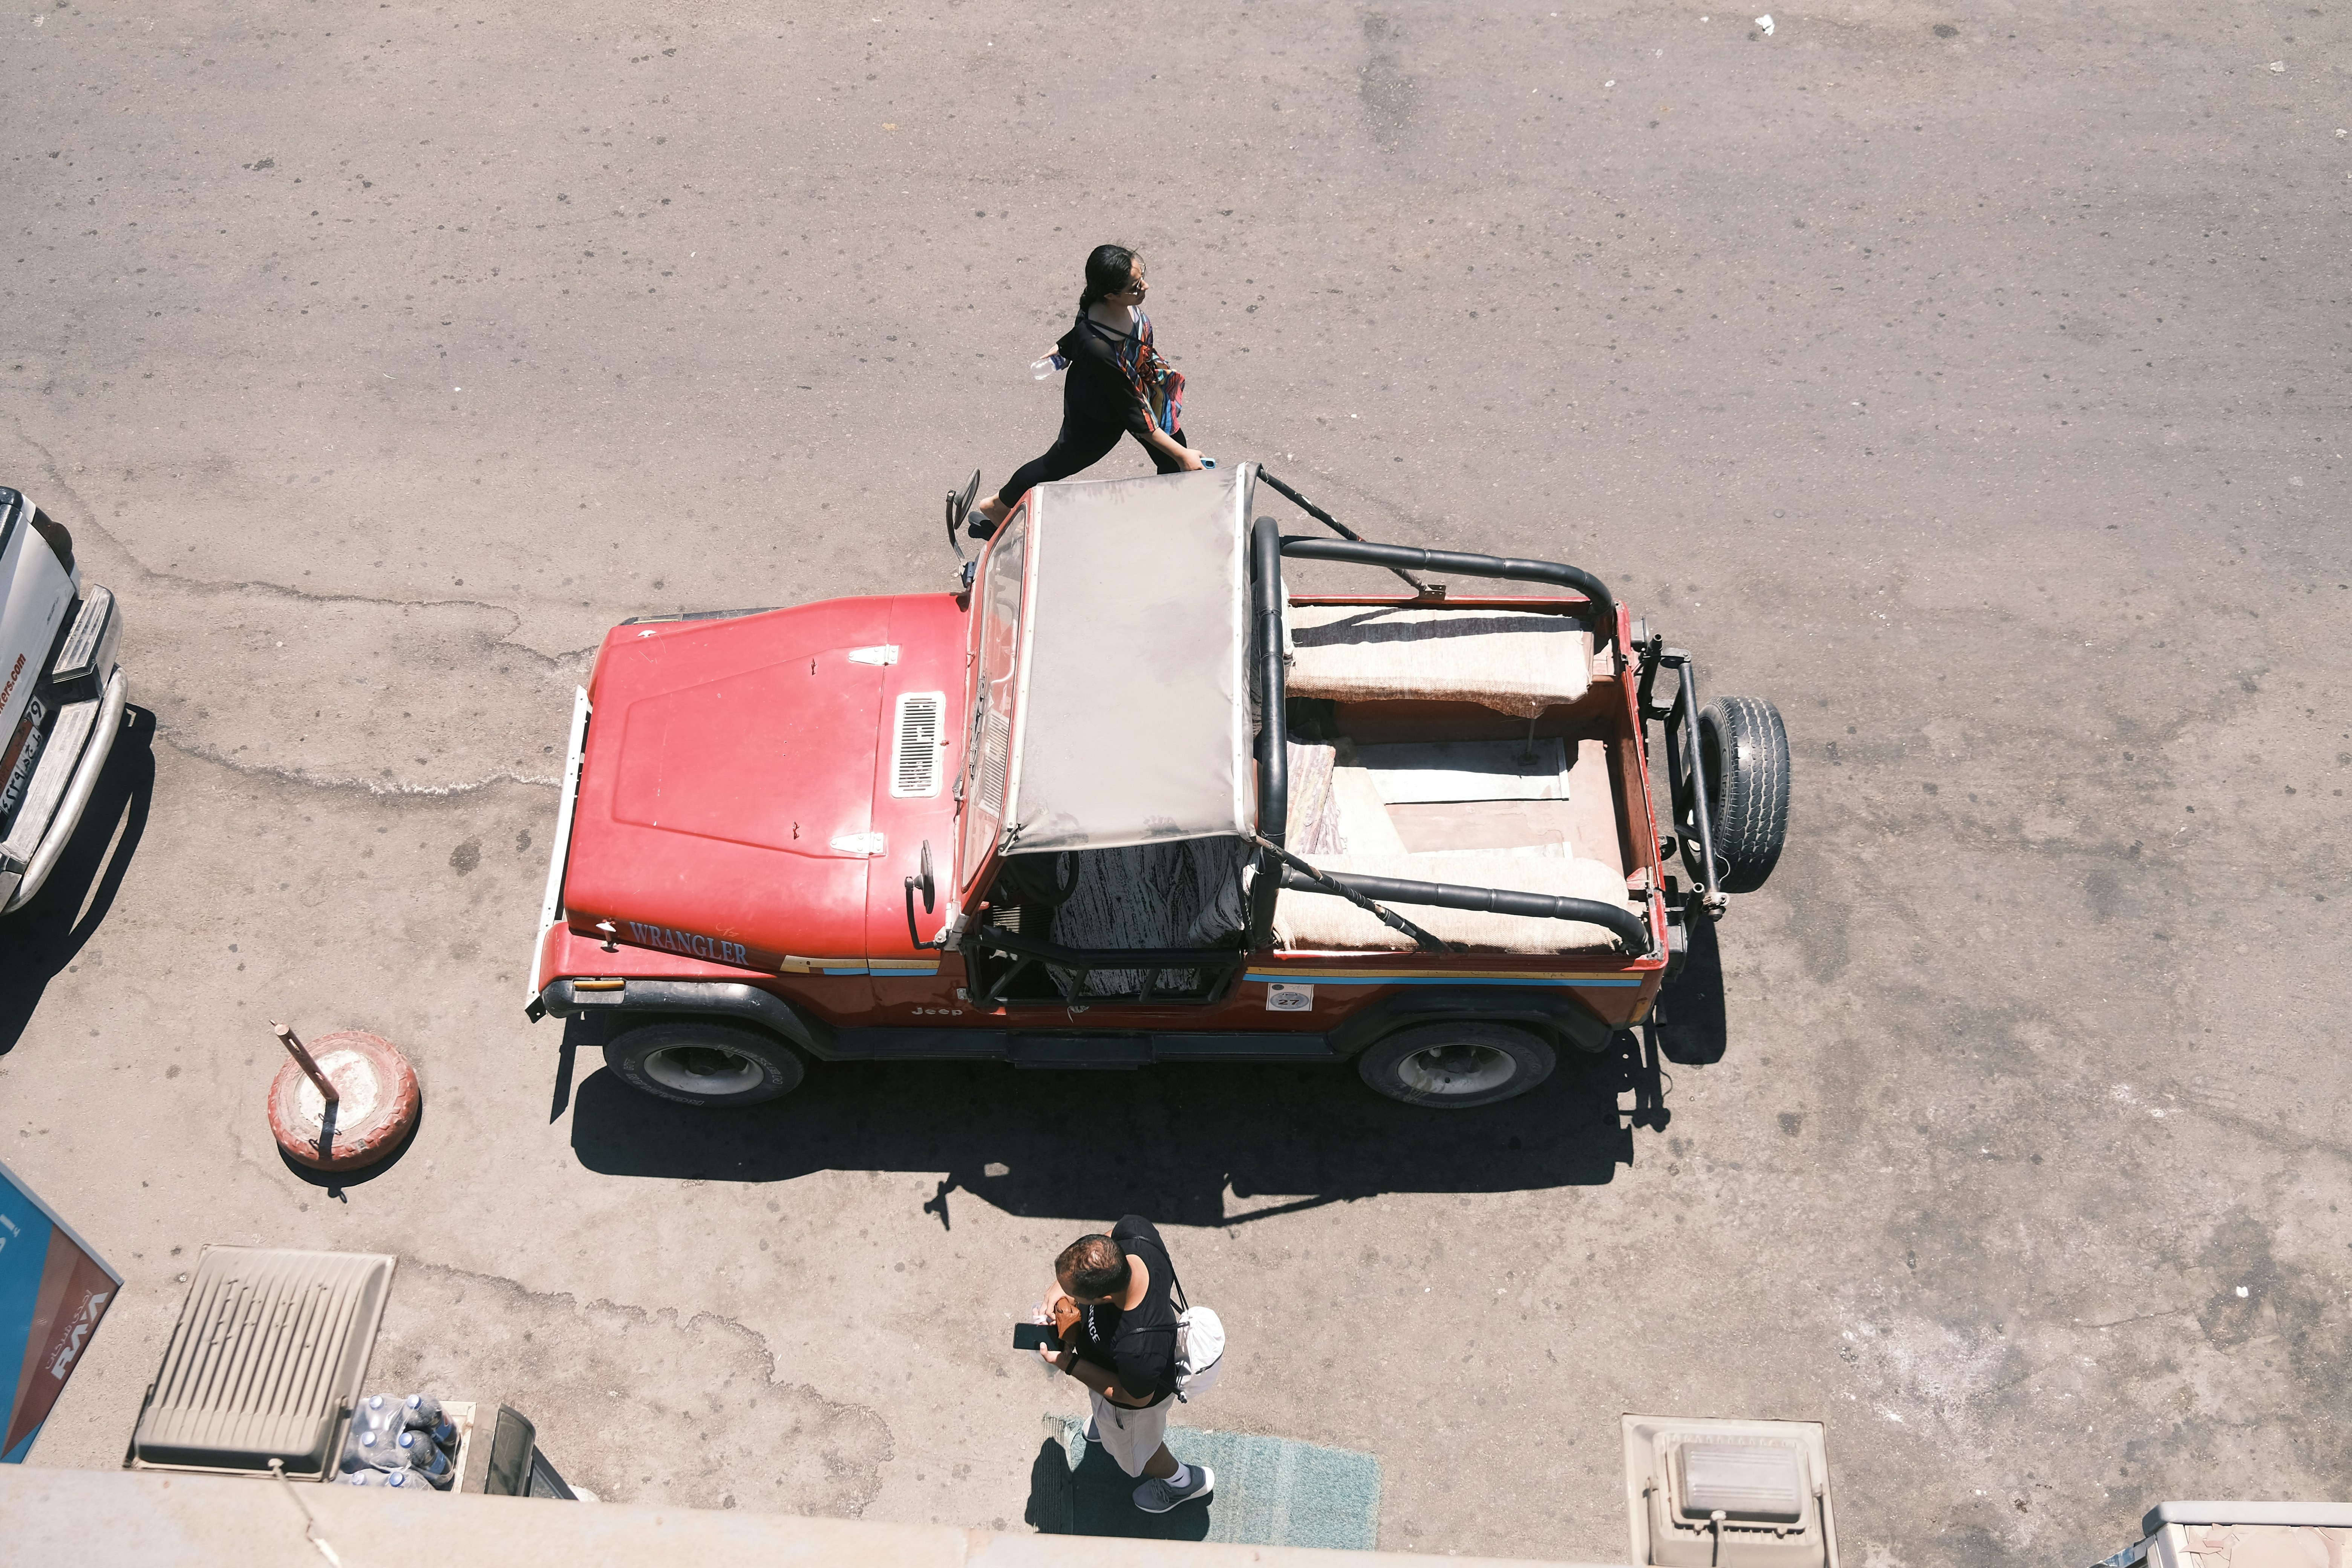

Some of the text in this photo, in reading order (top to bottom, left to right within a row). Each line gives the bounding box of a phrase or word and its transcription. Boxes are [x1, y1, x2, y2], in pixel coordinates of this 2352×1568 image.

[0, 653, 26, 715] kers.com
[629, 922, 749, 966] WRANGLER
[911, 1007, 963, 1016] Jeep
